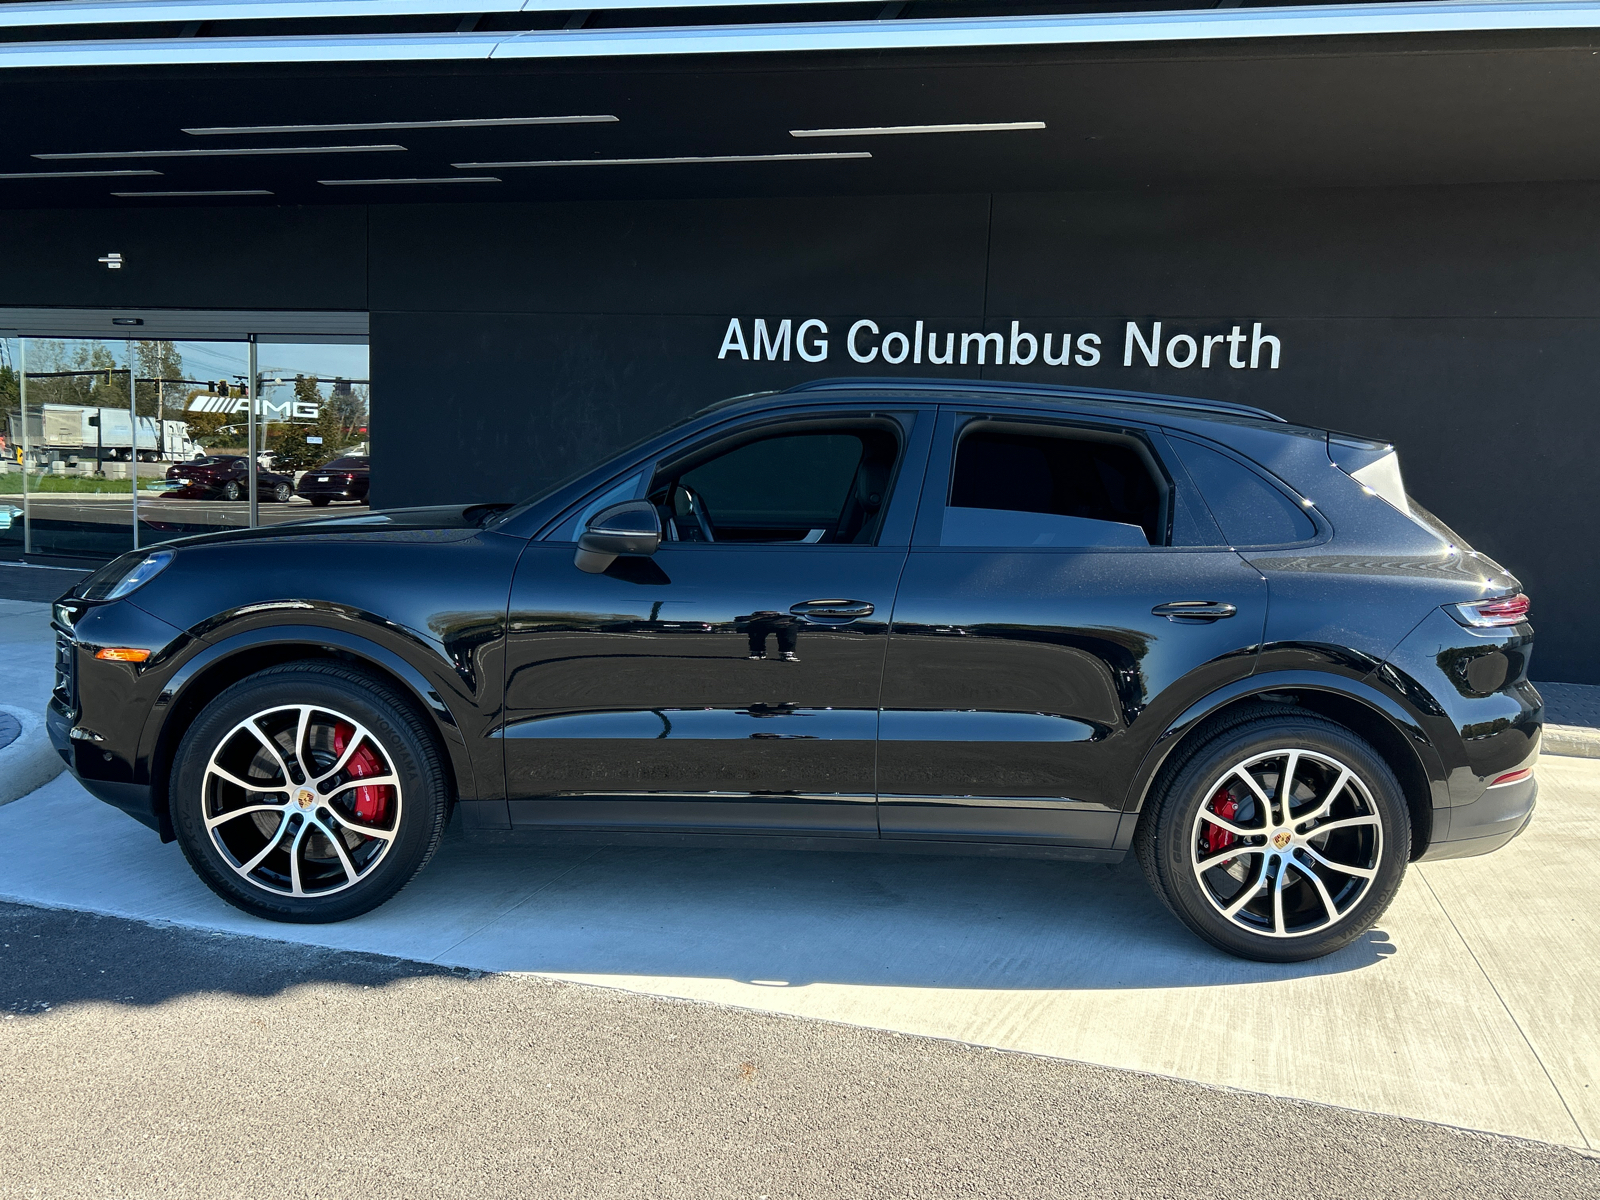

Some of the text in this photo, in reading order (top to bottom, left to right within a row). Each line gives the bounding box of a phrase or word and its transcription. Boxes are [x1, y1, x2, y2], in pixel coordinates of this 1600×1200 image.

[718, 318, 1281, 369] AMG Columbus North
[230, 398, 319, 418] AMG
[374, 715, 418, 781] YOKOHAMA
[1338, 888, 1391, 939] YOKOHAMA
